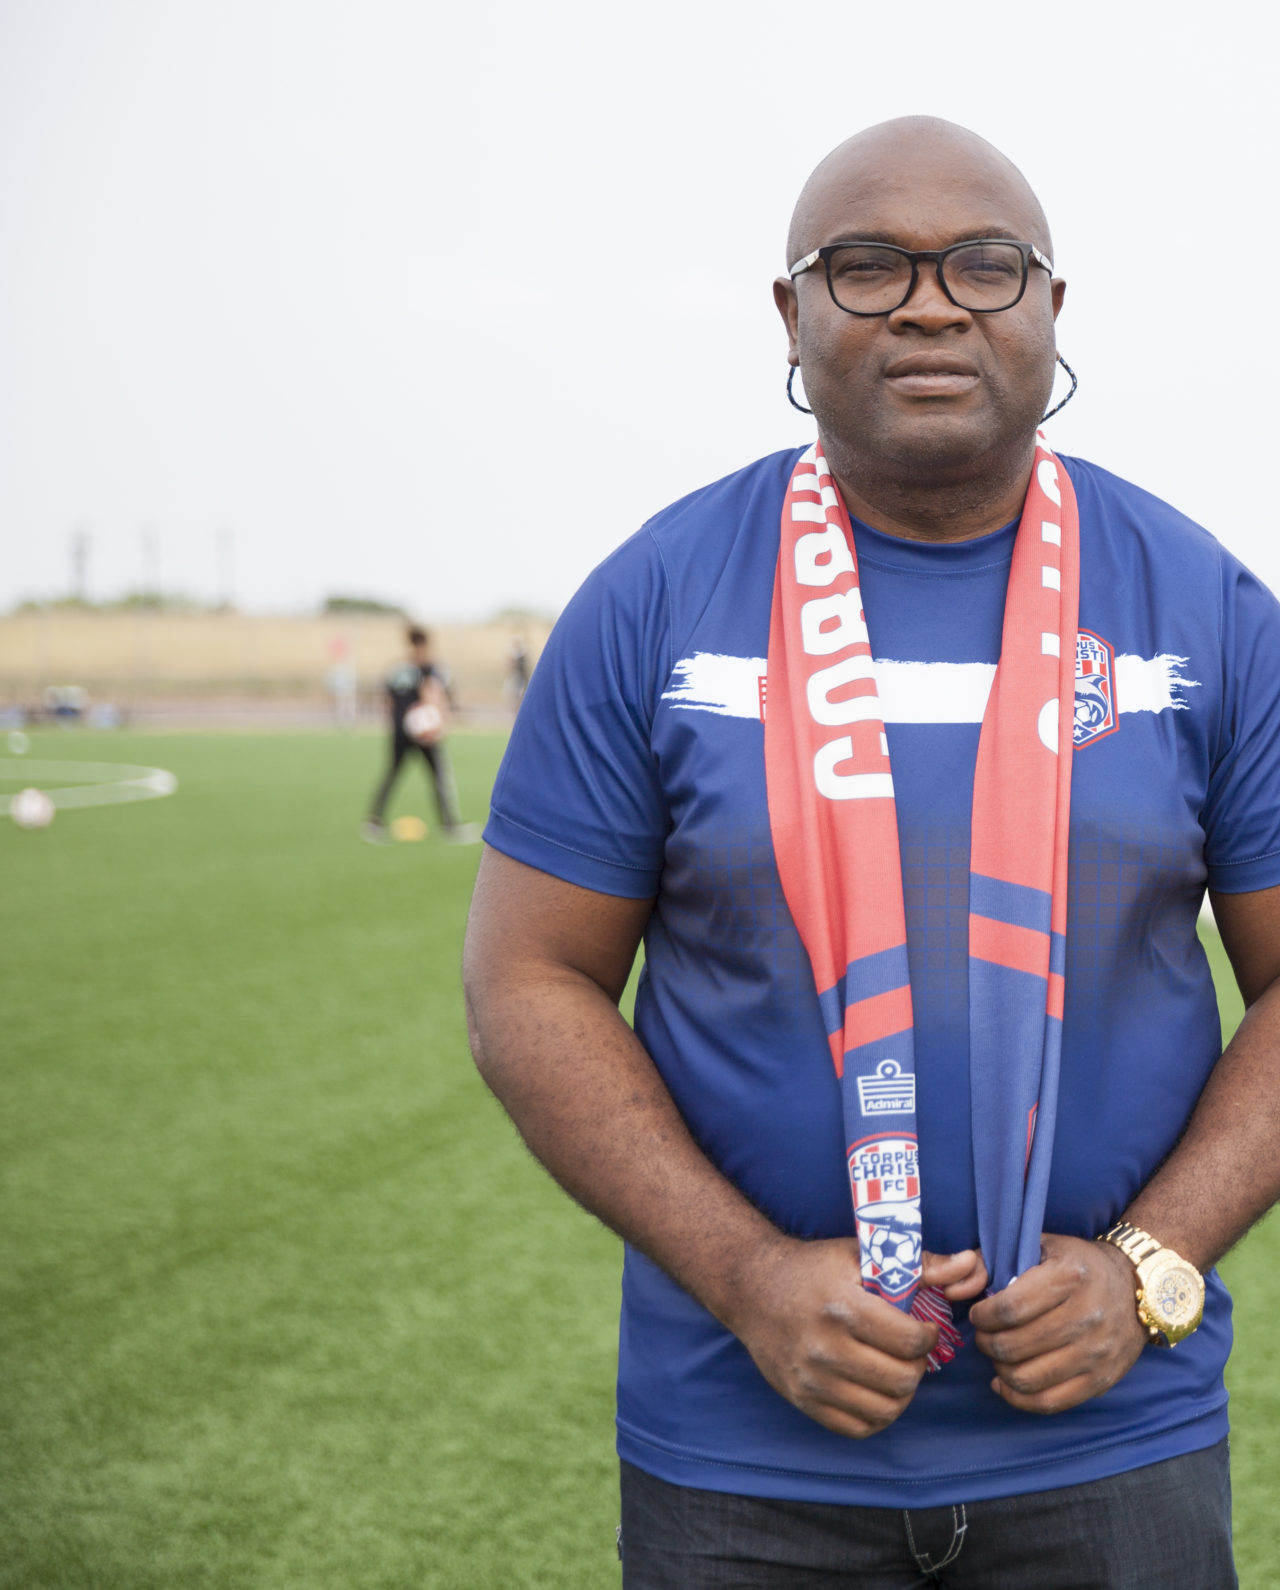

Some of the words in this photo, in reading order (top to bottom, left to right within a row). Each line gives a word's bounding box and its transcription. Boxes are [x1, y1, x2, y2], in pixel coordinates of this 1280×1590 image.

[791, 443, 895, 800] CORPU
[866, 1097, 913, 1110] Admiral
[860, 1150, 919, 1165] CORPUS
[852, 1162, 916, 1181] CHRIS
[884, 1179, 905, 1192] FC
